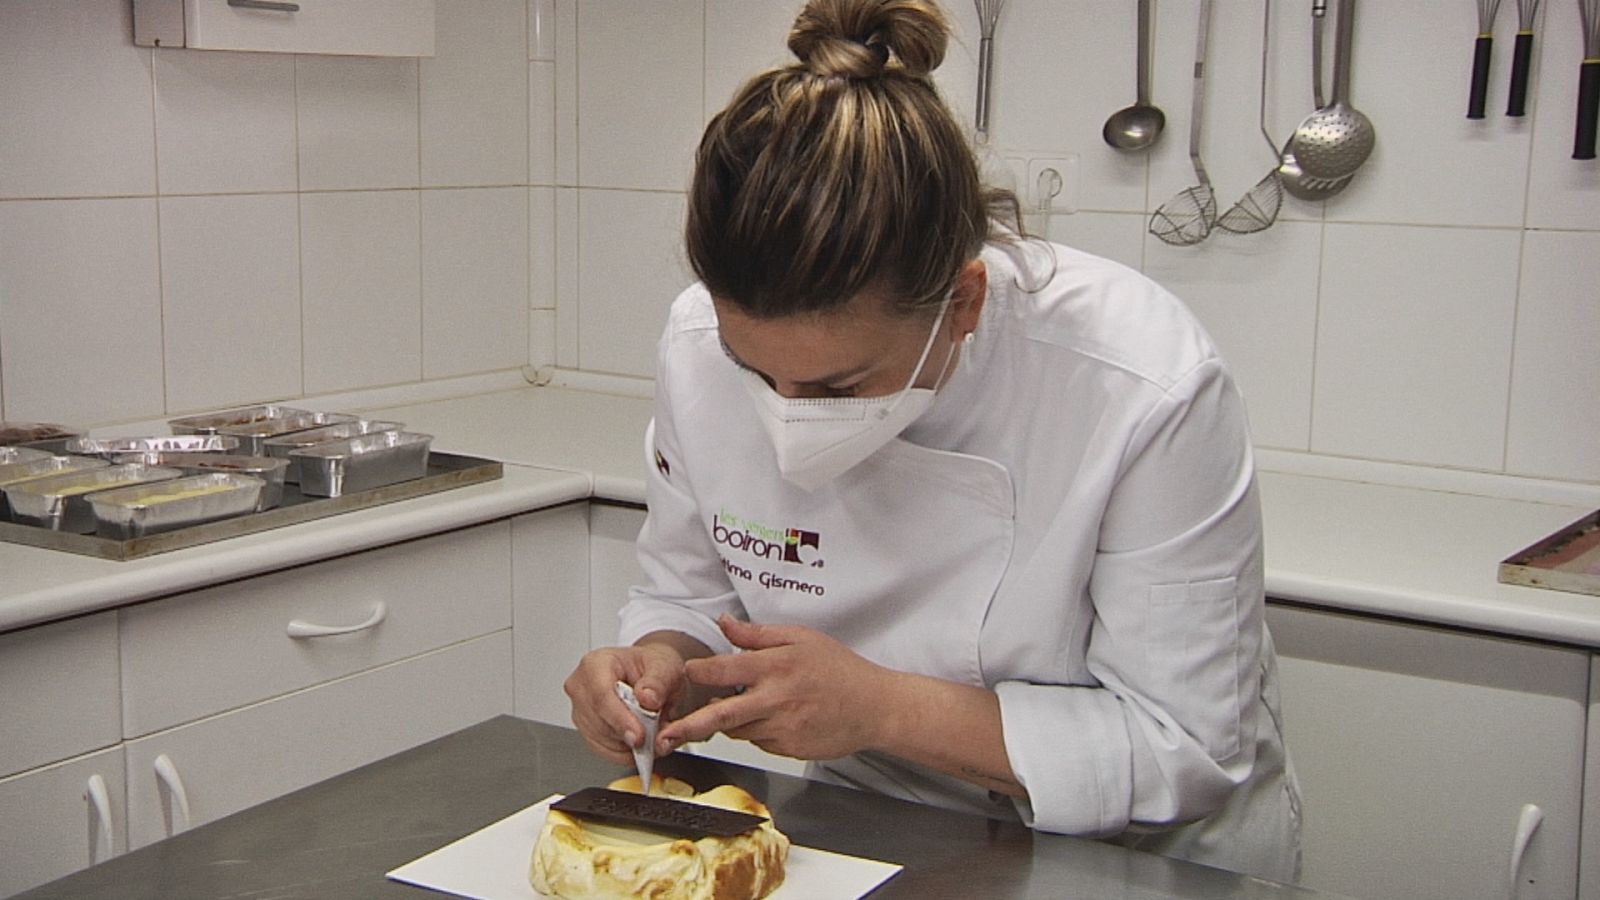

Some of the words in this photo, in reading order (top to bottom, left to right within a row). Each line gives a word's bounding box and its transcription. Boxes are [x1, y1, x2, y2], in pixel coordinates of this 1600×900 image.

[713, 514, 783, 561] boiron
[721, 558, 751, 581] tima
[759, 571, 824, 596] Gismero
